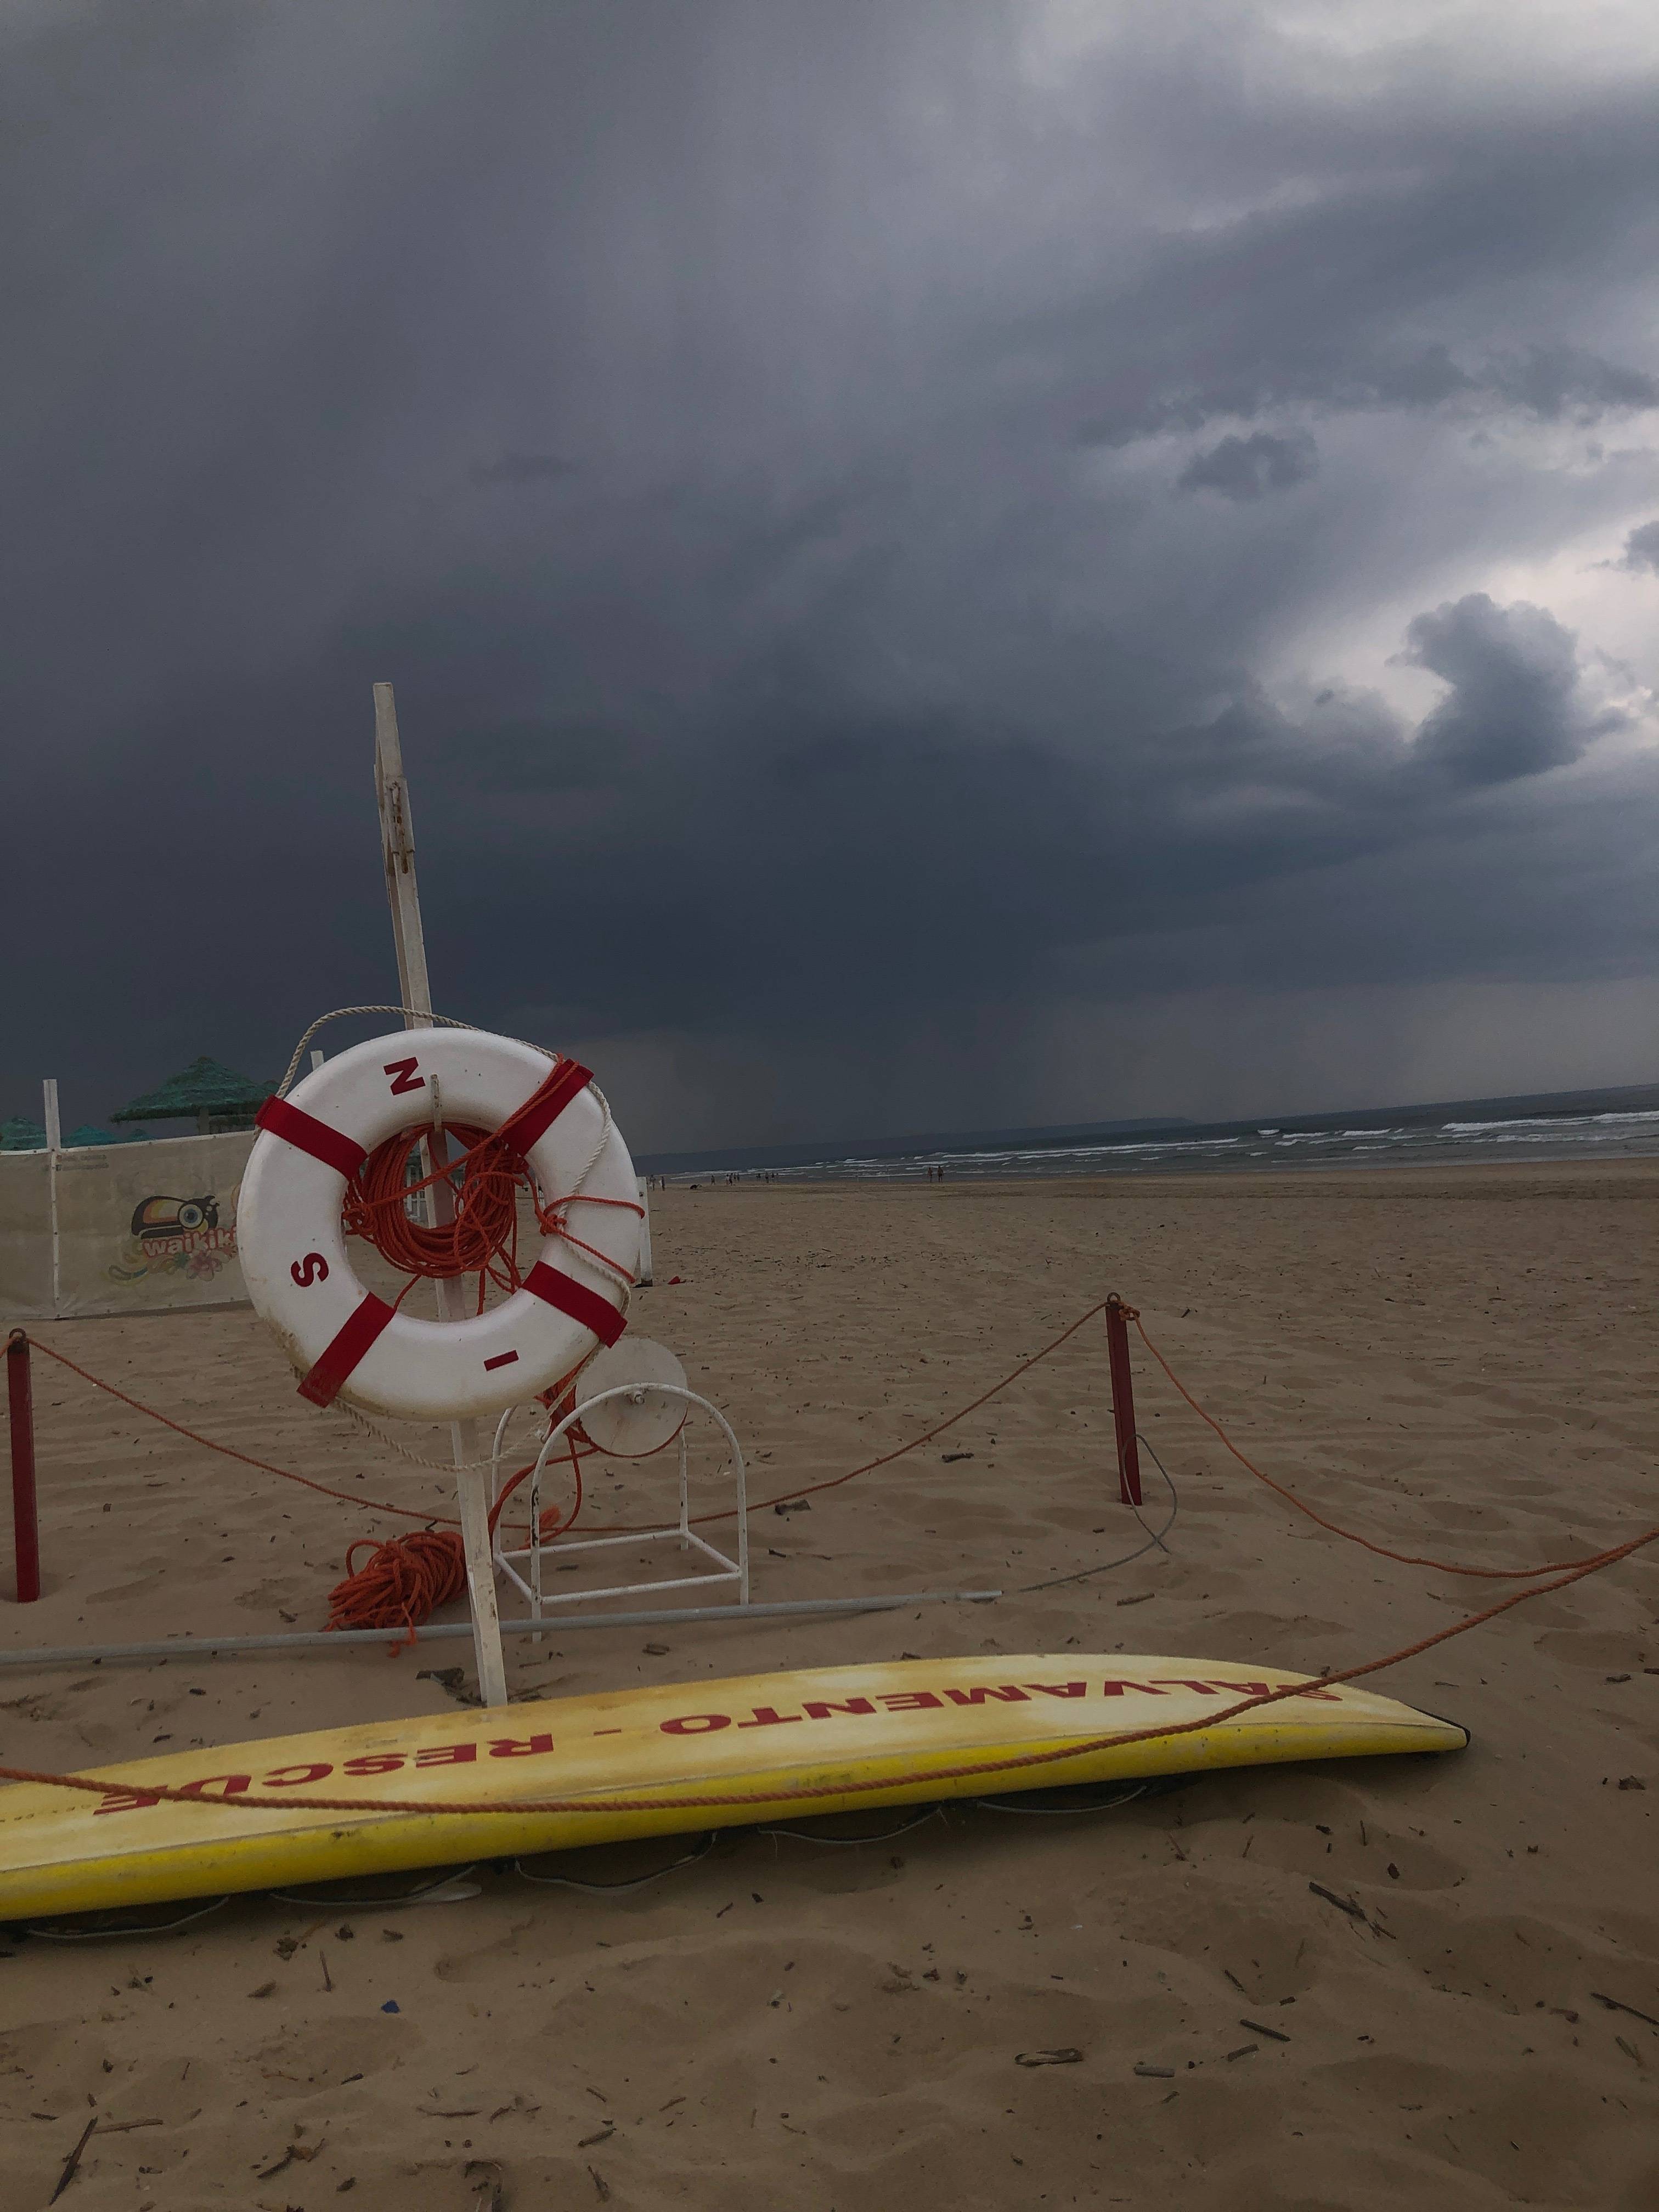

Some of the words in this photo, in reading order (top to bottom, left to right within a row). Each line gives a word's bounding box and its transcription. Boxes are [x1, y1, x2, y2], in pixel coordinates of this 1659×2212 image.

[290, 1252, 330, 1288] S
[383, 1056, 426, 1096] N
[93, 1733, 554, 1815] RESCUE
